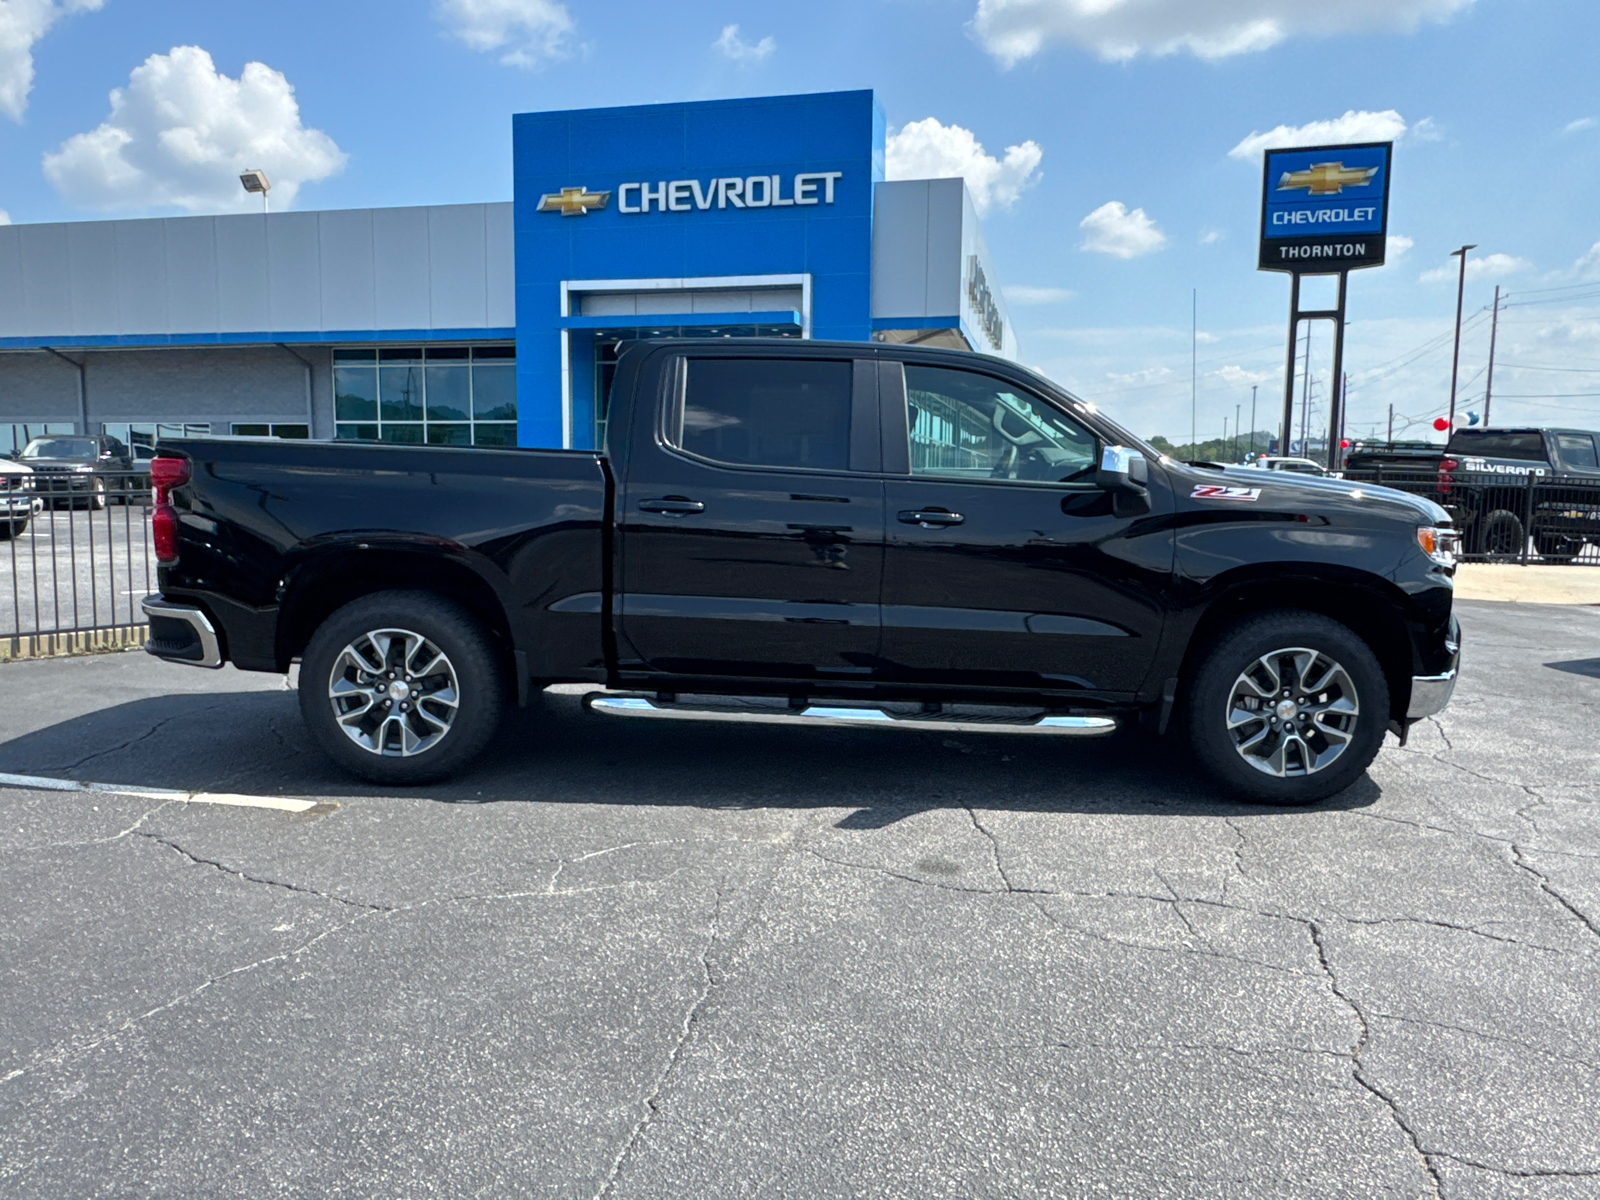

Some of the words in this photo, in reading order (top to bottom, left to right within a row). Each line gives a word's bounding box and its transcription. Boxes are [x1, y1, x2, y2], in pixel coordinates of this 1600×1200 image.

[618, 171, 842, 214] CHEVROLET
[1272, 207, 1376, 225] CHEVROLET
[1279, 243, 1365, 259] THORNTON
